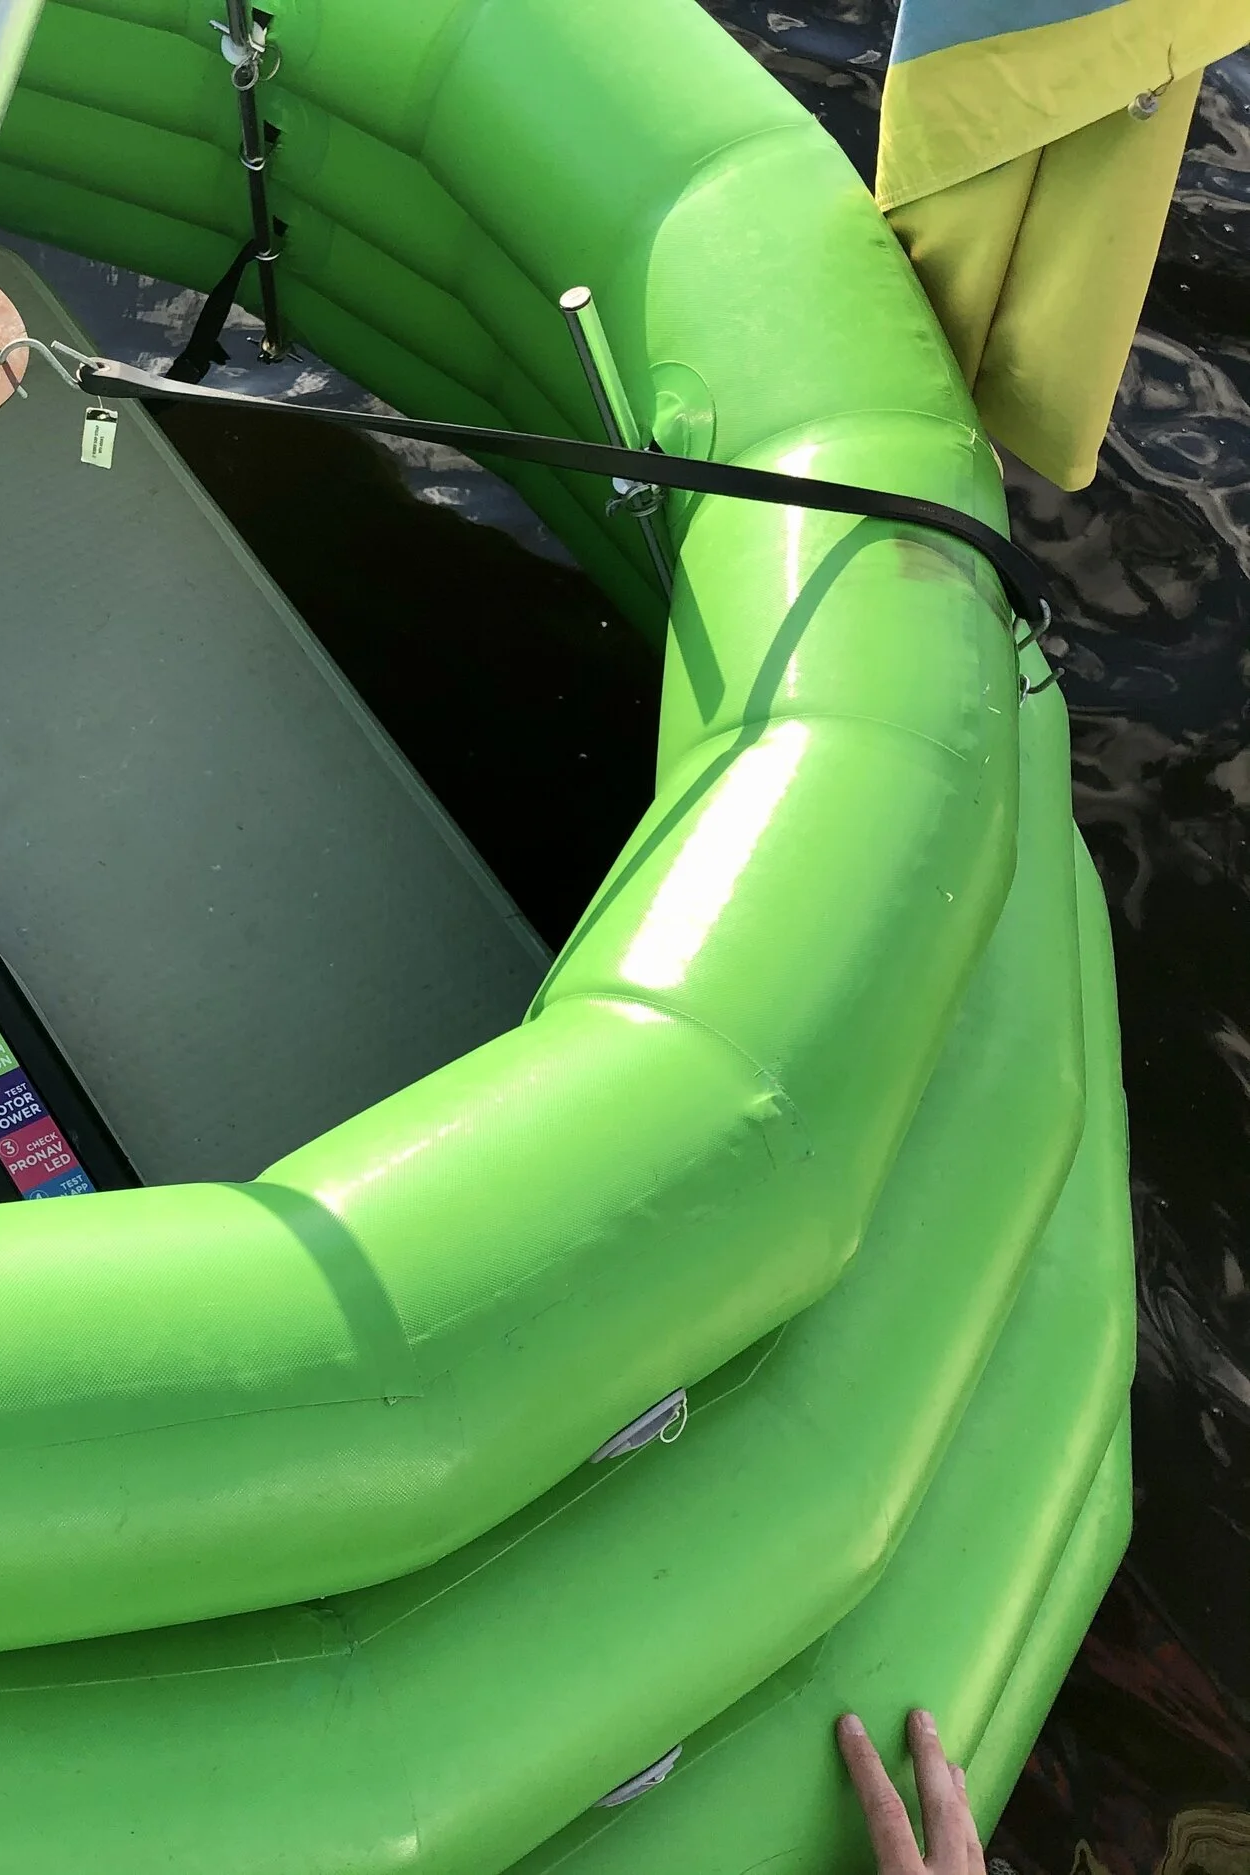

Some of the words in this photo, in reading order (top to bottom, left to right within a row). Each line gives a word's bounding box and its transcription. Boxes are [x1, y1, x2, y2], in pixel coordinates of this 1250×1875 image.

[4, 1082, 28, 1098] TEST
[2, 1141, 16, 1155] 3
[26, 1131, 59, 1152] CHECK
[8, 1140, 63, 1175] PRONAV
[44, 1153, 71, 1173] LED
[59, 1174, 84, 1191] TEST
